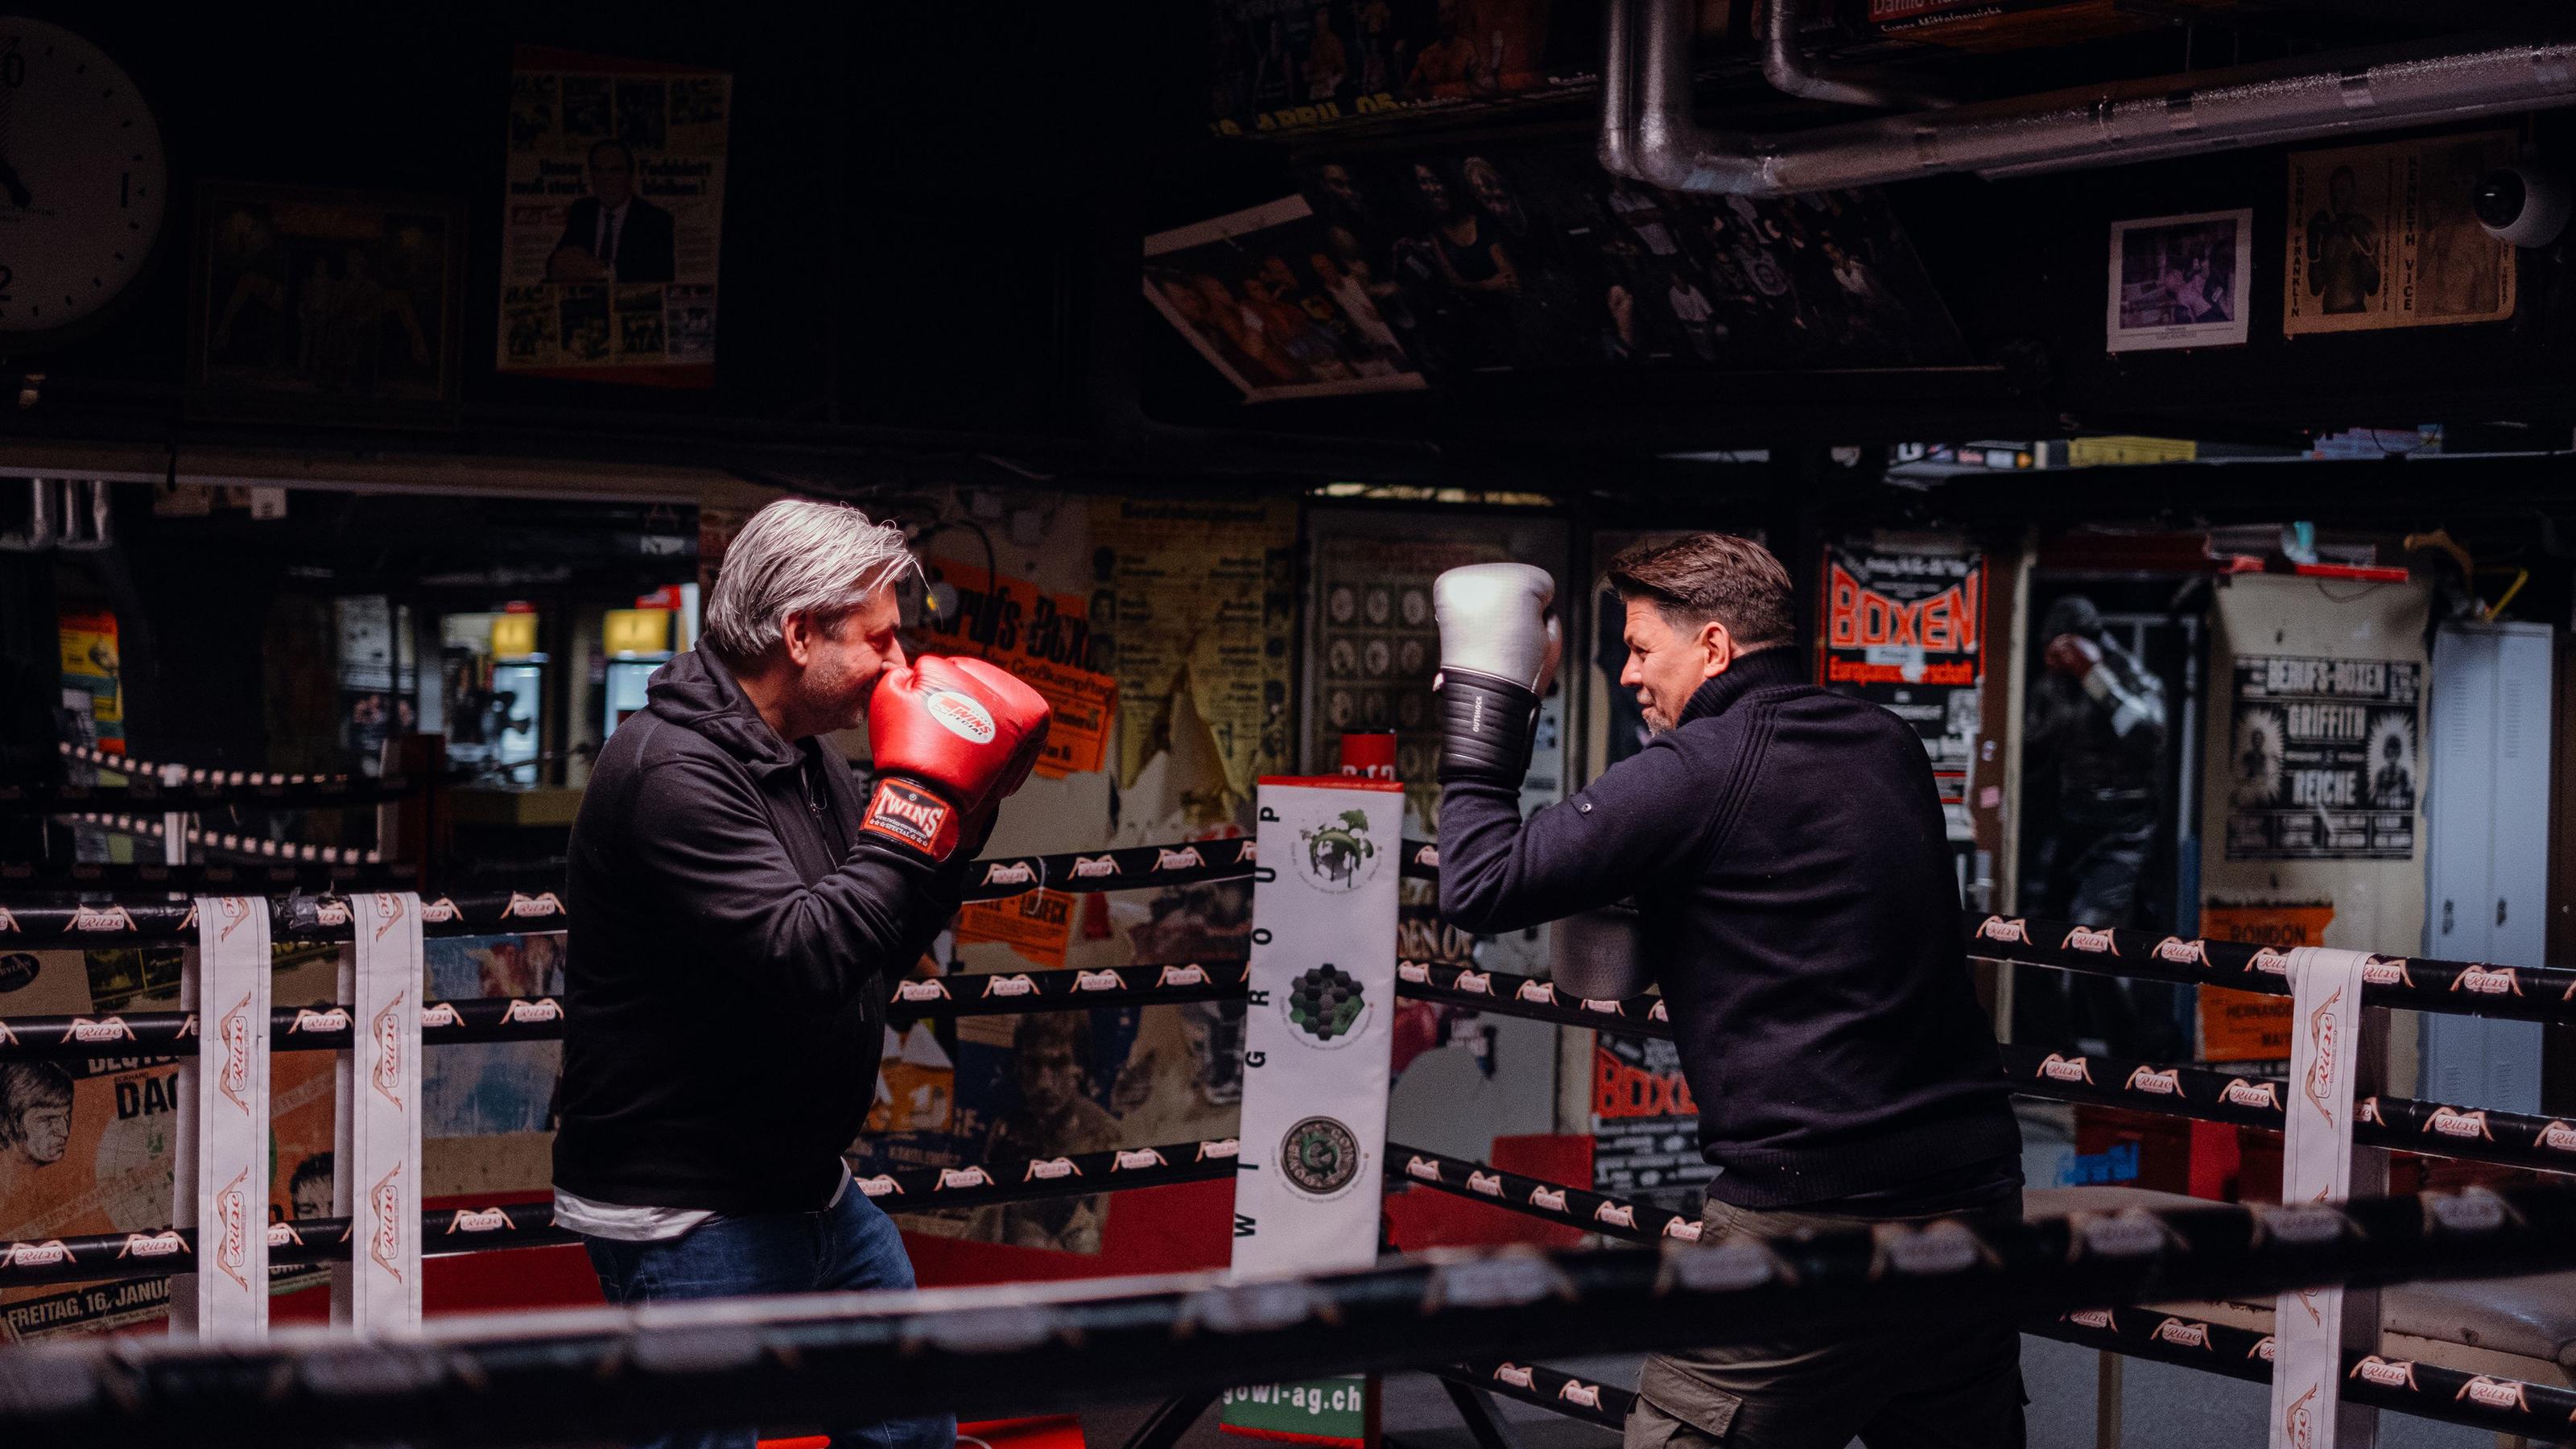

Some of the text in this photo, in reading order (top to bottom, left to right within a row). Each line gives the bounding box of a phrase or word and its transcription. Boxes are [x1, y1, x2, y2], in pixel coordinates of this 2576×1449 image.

[2402, 259, 2414, 312] VICE
[1830, 561, 1978, 654] BOXEN
[875, 785, 944, 838] TWINS
[82, 915, 123, 928] Ritze
[2468, 975, 2508, 988] Ritze
[80, 1026, 122, 1038] Ritze
[231, 1018, 243, 1082] Ritze
[384, 1016, 396, 1078] Ritze
[2318, 1016, 2333, 1086] Ritze
[2048, 1063, 2081, 1075] Ritze
[2136, 1075, 2172, 1088] Ritze
[2231, 1088, 2268, 1103] Ritze
[2438, 1117, 2479, 1131] Ritze
[229, 1193, 241, 1257] Ritze
[382, 1187, 395, 1253] Ritze
[136, 1240, 179, 1253] Ritze
[19, 1249, 63, 1263] Ritze
[2164, 1327, 2202, 1342] Ritze
[2363, 1365, 2405, 1381] Ritze
[2473, 1385, 2516, 1402] Ritze
